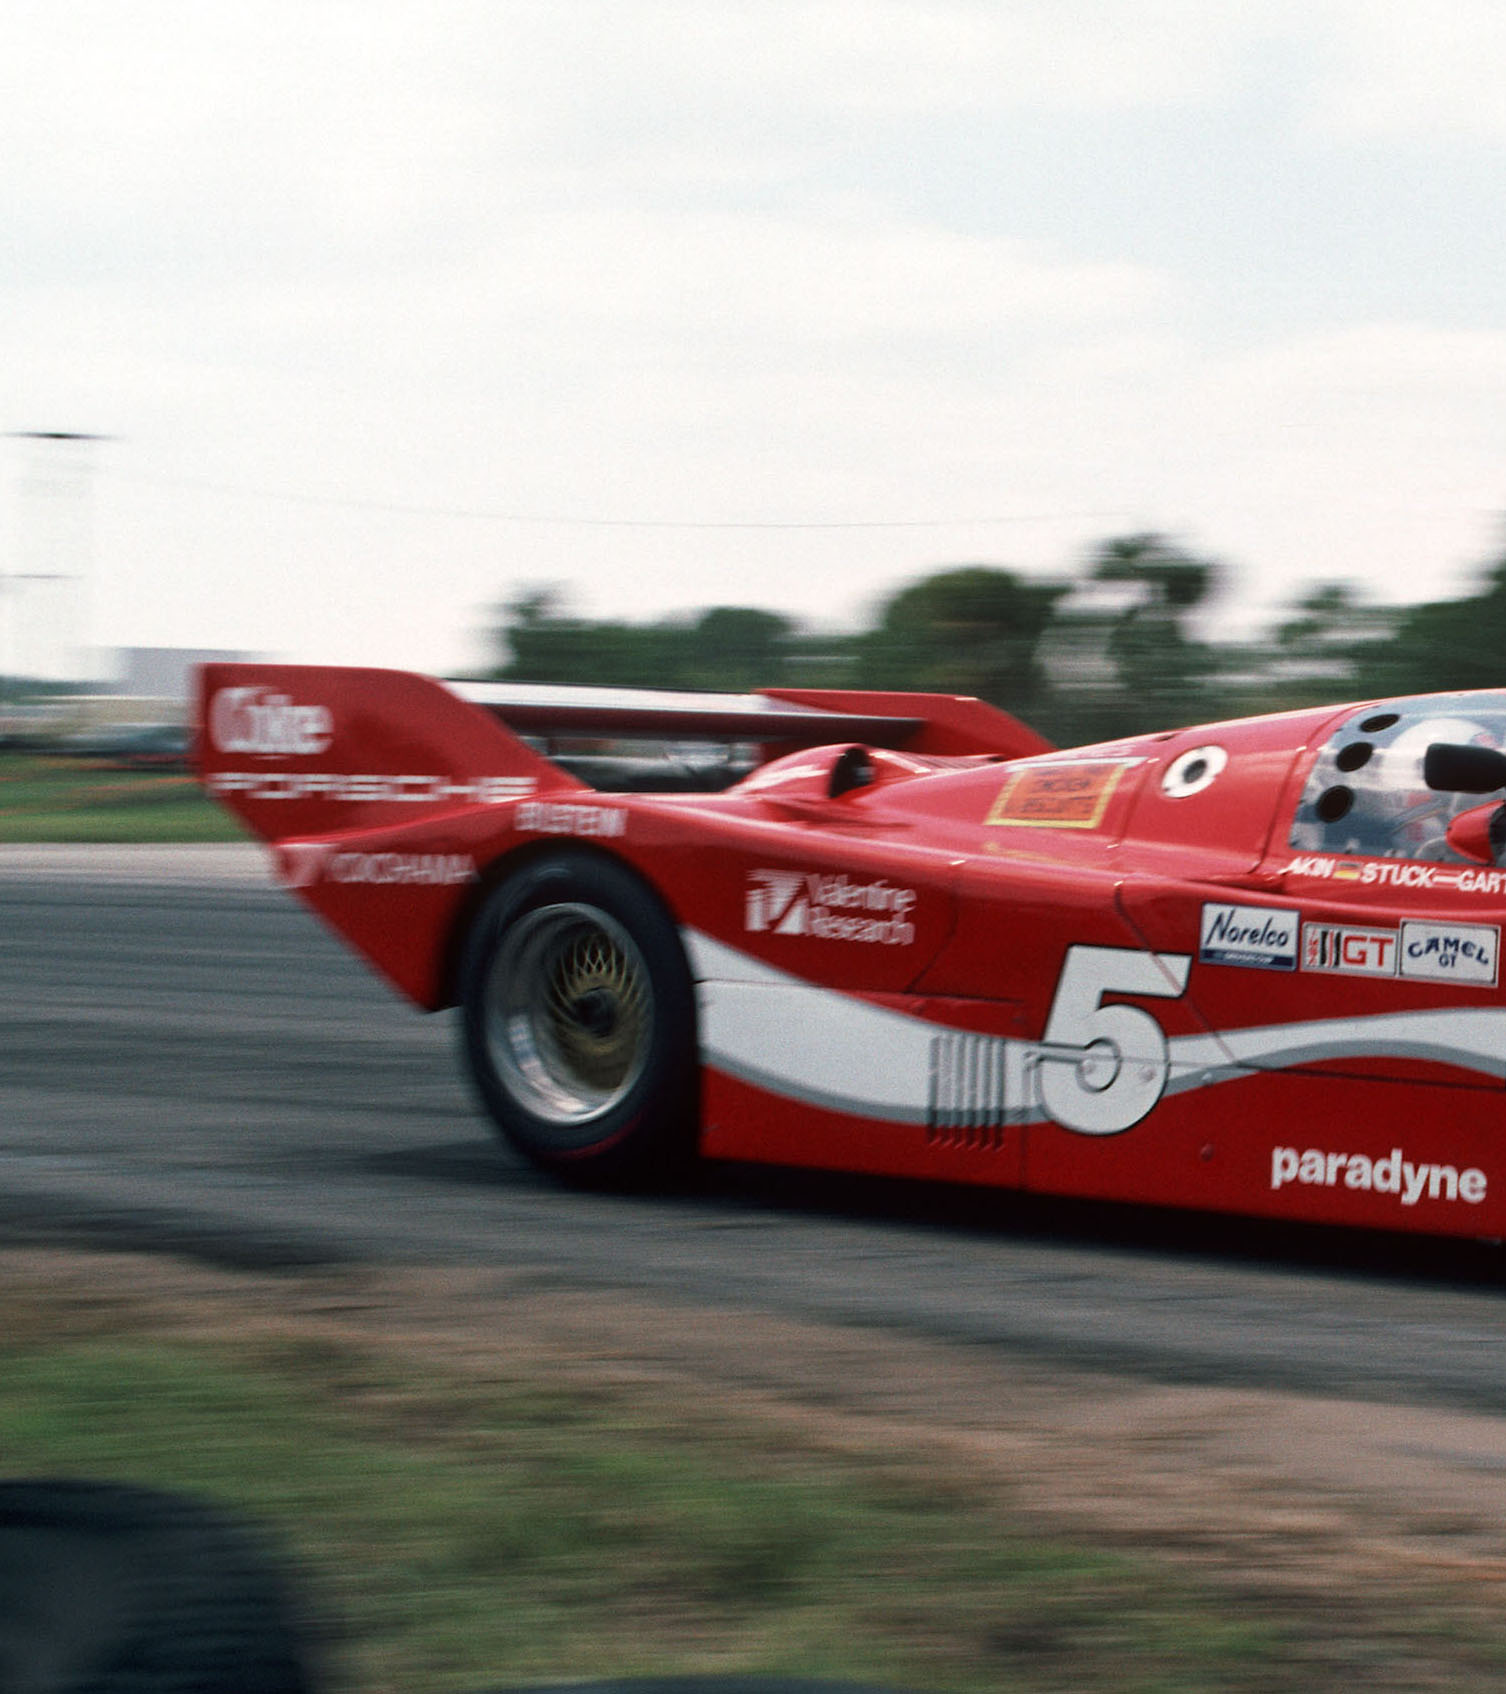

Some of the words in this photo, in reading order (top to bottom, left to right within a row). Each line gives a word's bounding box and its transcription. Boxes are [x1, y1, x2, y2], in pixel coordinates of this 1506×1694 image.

[205, 772, 537, 803] PORSCHE
[1361, 862, 1437, 888] STUCK
[1205, 907, 1289, 948] Norelco
[1343, 935, 1395, 967] GT
[1407, 936, 1490, 966] CAMEL
[1438, 952, 1456, 968] GT
[1034, 945, 1193, 1135] 5
[1272, 1146, 1488, 1204] paradyne
